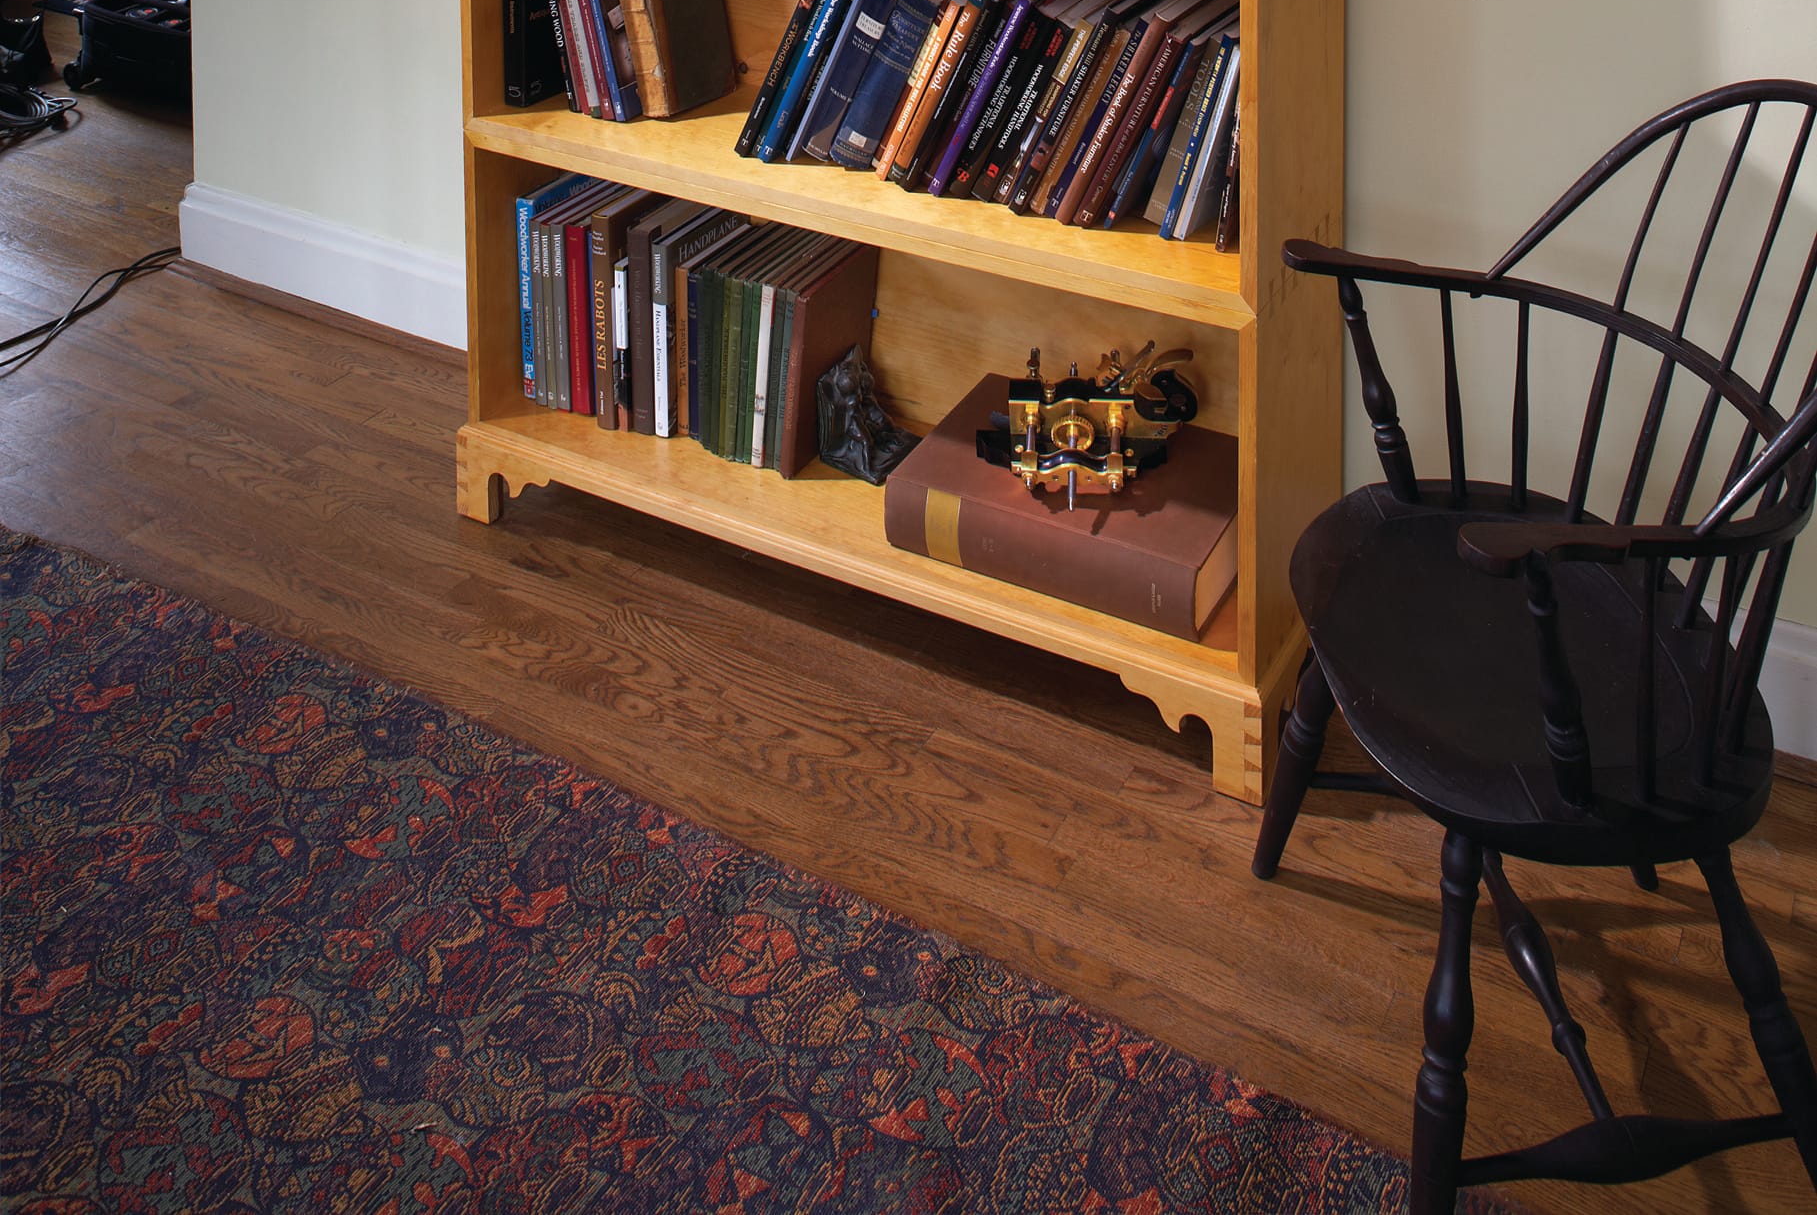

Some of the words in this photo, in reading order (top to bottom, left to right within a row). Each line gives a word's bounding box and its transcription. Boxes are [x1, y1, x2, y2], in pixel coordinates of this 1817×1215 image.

[553, 23, 565, 47] WOOD
[814, 6, 834, 40] Workshop
[957, 10, 971, 28] The
[1076, 28, 1086, 40] THE
[806, 39, 819, 58] Book
[927, 41, 940, 62] SOURCE
[943, 28, 965, 59] Rule
[1064, 38, 1081, 63] PERFECT
[1089, 22, 1109, 52] Pleasant
[766, 29, 796, 87] WORKBENCH
[920, 61, 931, 77] BOOK
[966, 38, 997, 87] FURNITURE
[1057, 62, 1069, 78] EDGE
[1083, 50, 1095, 66] Hill
[1115, 38, 1138, 73] SHAKER
[1147, 44, 1172, 86] AMERICAN
[915, 77, 923, 88] FOR
[928, 58, 952, 92] Book
[989, 55, 1018, 106] WOODWORKING
[1015, 63, 1043, 110] WOODWORKING
[1068, 64, 1088, 96] SHAKER
[1100, 72, 1121, 105] LEGACY
[1121, 71, 1135, 89] The
[1184, 57, 1210, 110] TOOLS
[909, 88, 918, 101] RULE
[985, 84, 1011, 129] TRADITIONAL
[1013, 89, 1037, 131] TRADITIONAL
[1111, 87, 1128, 109] Book
[1126, 86, 1152, 129] FURNITURE
[896, 101, 913, 131] COLLECTORS
[968, 106, 992, 150] TECHNIQUES
[1048, 95, 1073, 137] FURNITURE
[1095, 115, 1113, 141] Shaker
[1107, 107, 1117, 118] of
[1078, 139, 1101, 174] Furniture
[1100, 152, 1118, 182] CENTURY
[519, 207, 529, 272] Woodworker
[531, 230, 540, 273] WOODWORKING
[540, 235, 549, 277] WOODWORKING
[552, 233, 561, 276] WOODWORKING
[676, 216, 741, 263] HANDPLANE
[653, 253, 661, 293] WOODWORKING
[521, 273, 531, 309] Annual
[593, 278, 605, 340] RABOTS
[523, 310, 532, 346] Volume
[524, 348, 532, 361] 73
[596, 344, 606, 370] LES
